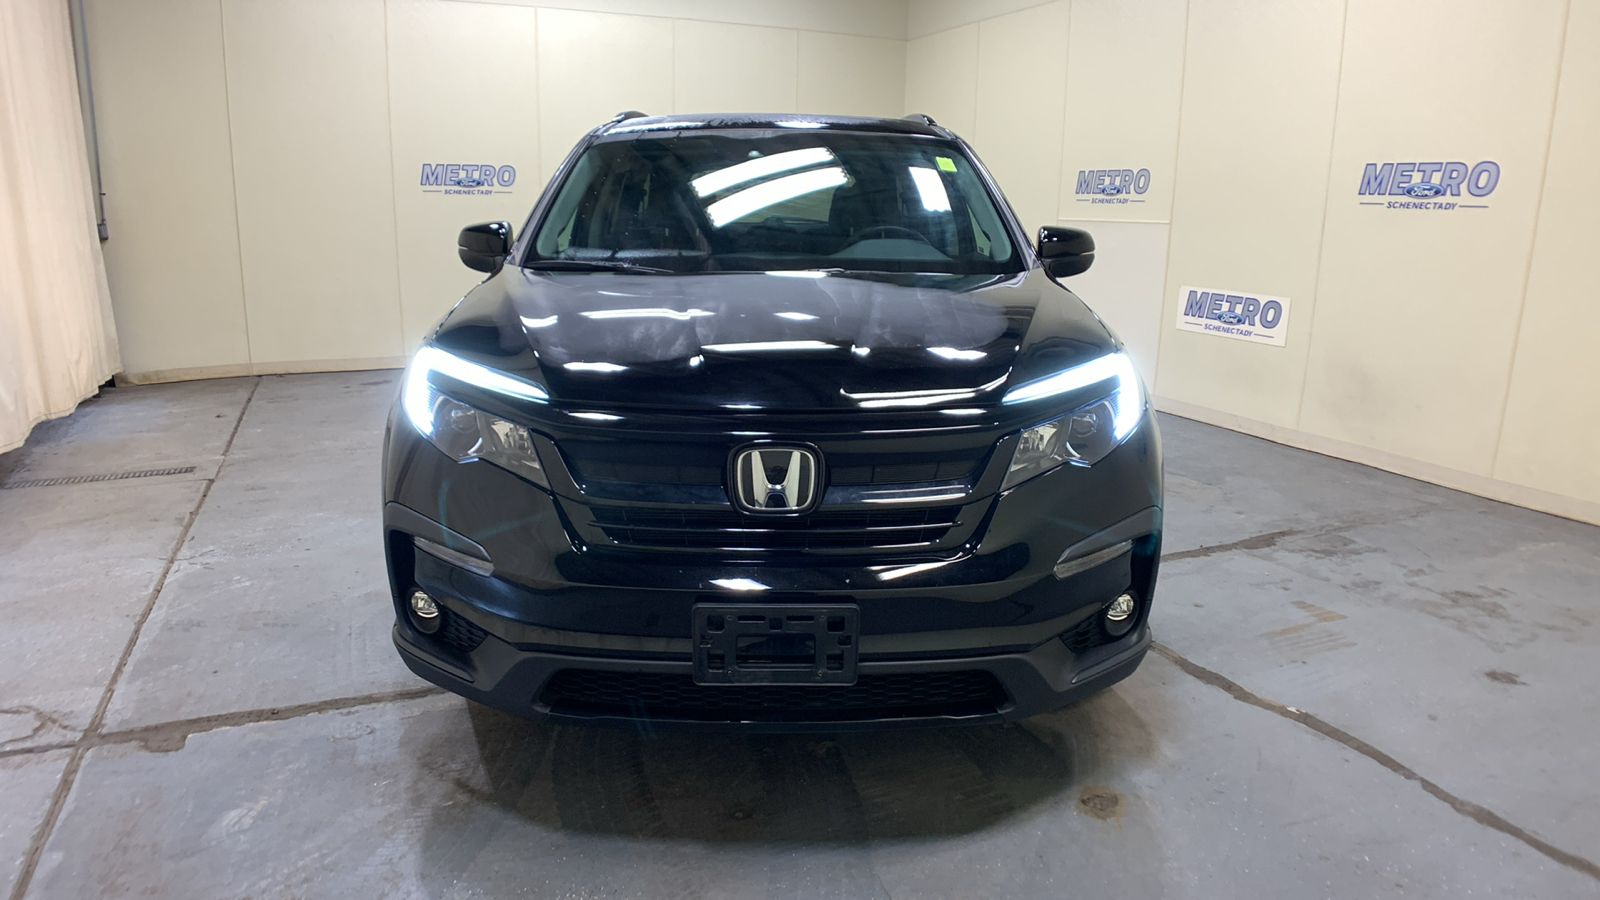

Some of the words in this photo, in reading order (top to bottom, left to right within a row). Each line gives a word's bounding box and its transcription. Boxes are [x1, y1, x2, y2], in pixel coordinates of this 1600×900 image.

[420, 163, 516, 187] METRO
[1075, 168, 1151, 195] METRO
[1358, 161, 1501, 197] METRO
[1411, 185, 1437, 197] Ford
[1386, 201, 1458, 210] SCHENECTADY
[1183, 290, 1283, 329] METRO
[1221, 313, 1239, 324] Ford
[1204, 323, 1254, 337] SCHENECTADY
